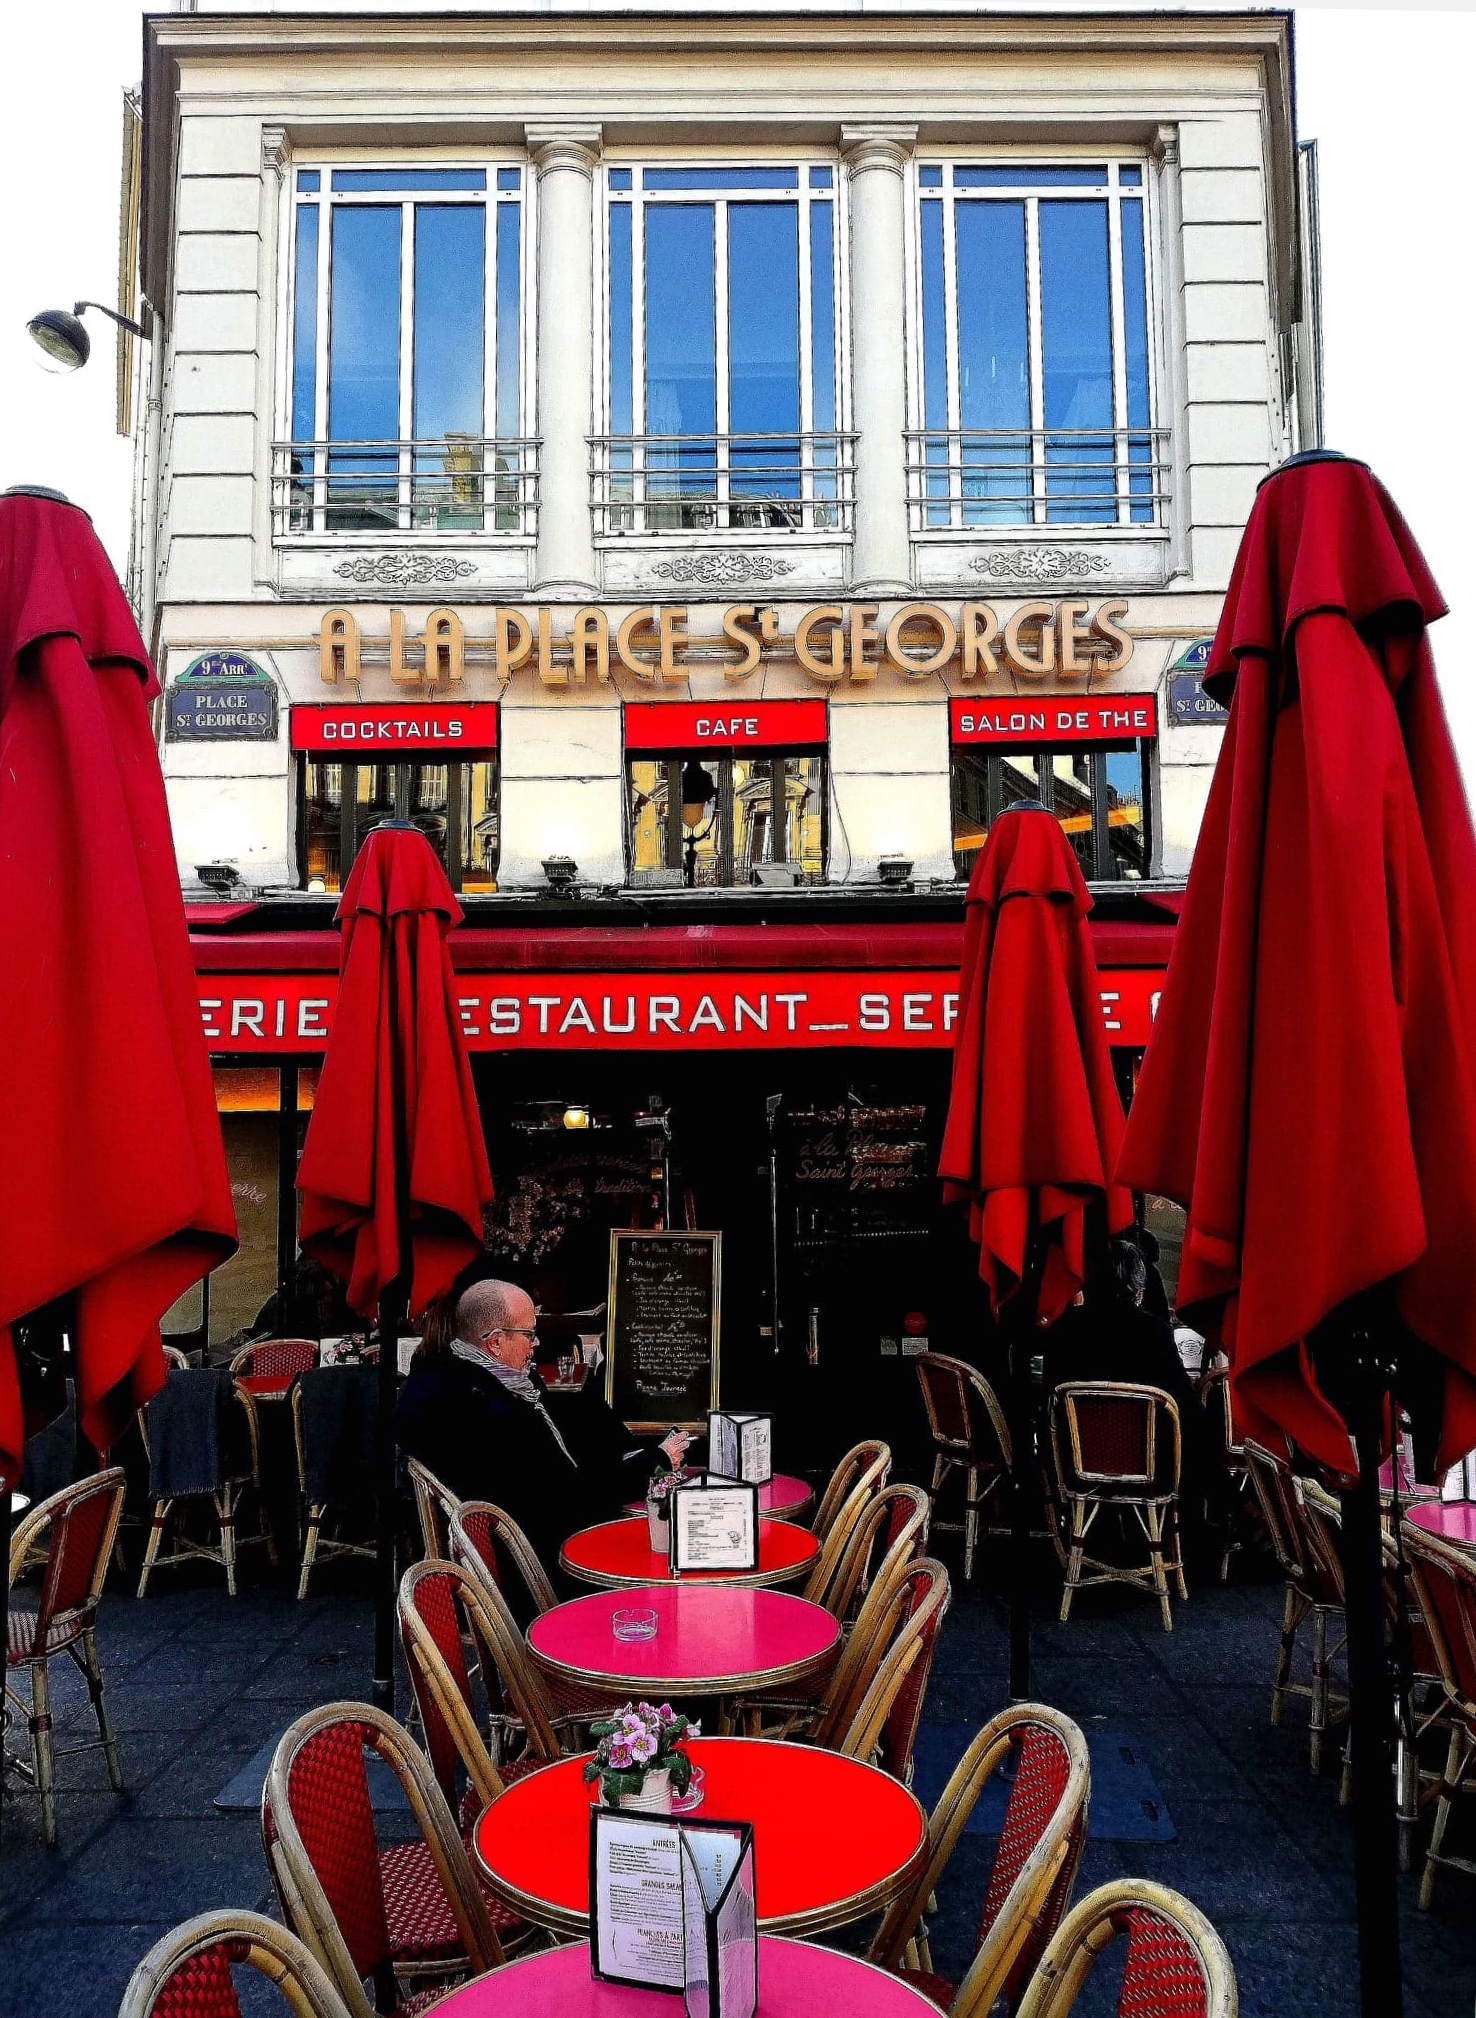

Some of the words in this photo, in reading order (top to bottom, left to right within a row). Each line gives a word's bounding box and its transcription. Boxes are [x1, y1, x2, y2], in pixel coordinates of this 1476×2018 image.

[317, 608, 361, 684] A
[390, 608, 464, 684] LA
[495, 606, 689, 684] PLACE
[794, 600, 1135, 680] GEORGES
[195, 695, 248, 708] PLACE
[195, 713, 268, 727] GEORGES
[322, 720, 463, 739] COCKTAILS
[695, 717, 759, 737] CAFE
[959, 712, 1045, 732] SALON
[1057, 711, 1089, 730] DE
[1097, 709, 1147, 729] THE
[200, 999, 329, 1037] ERIE
[796, 1160, 846, 1179] Saint
